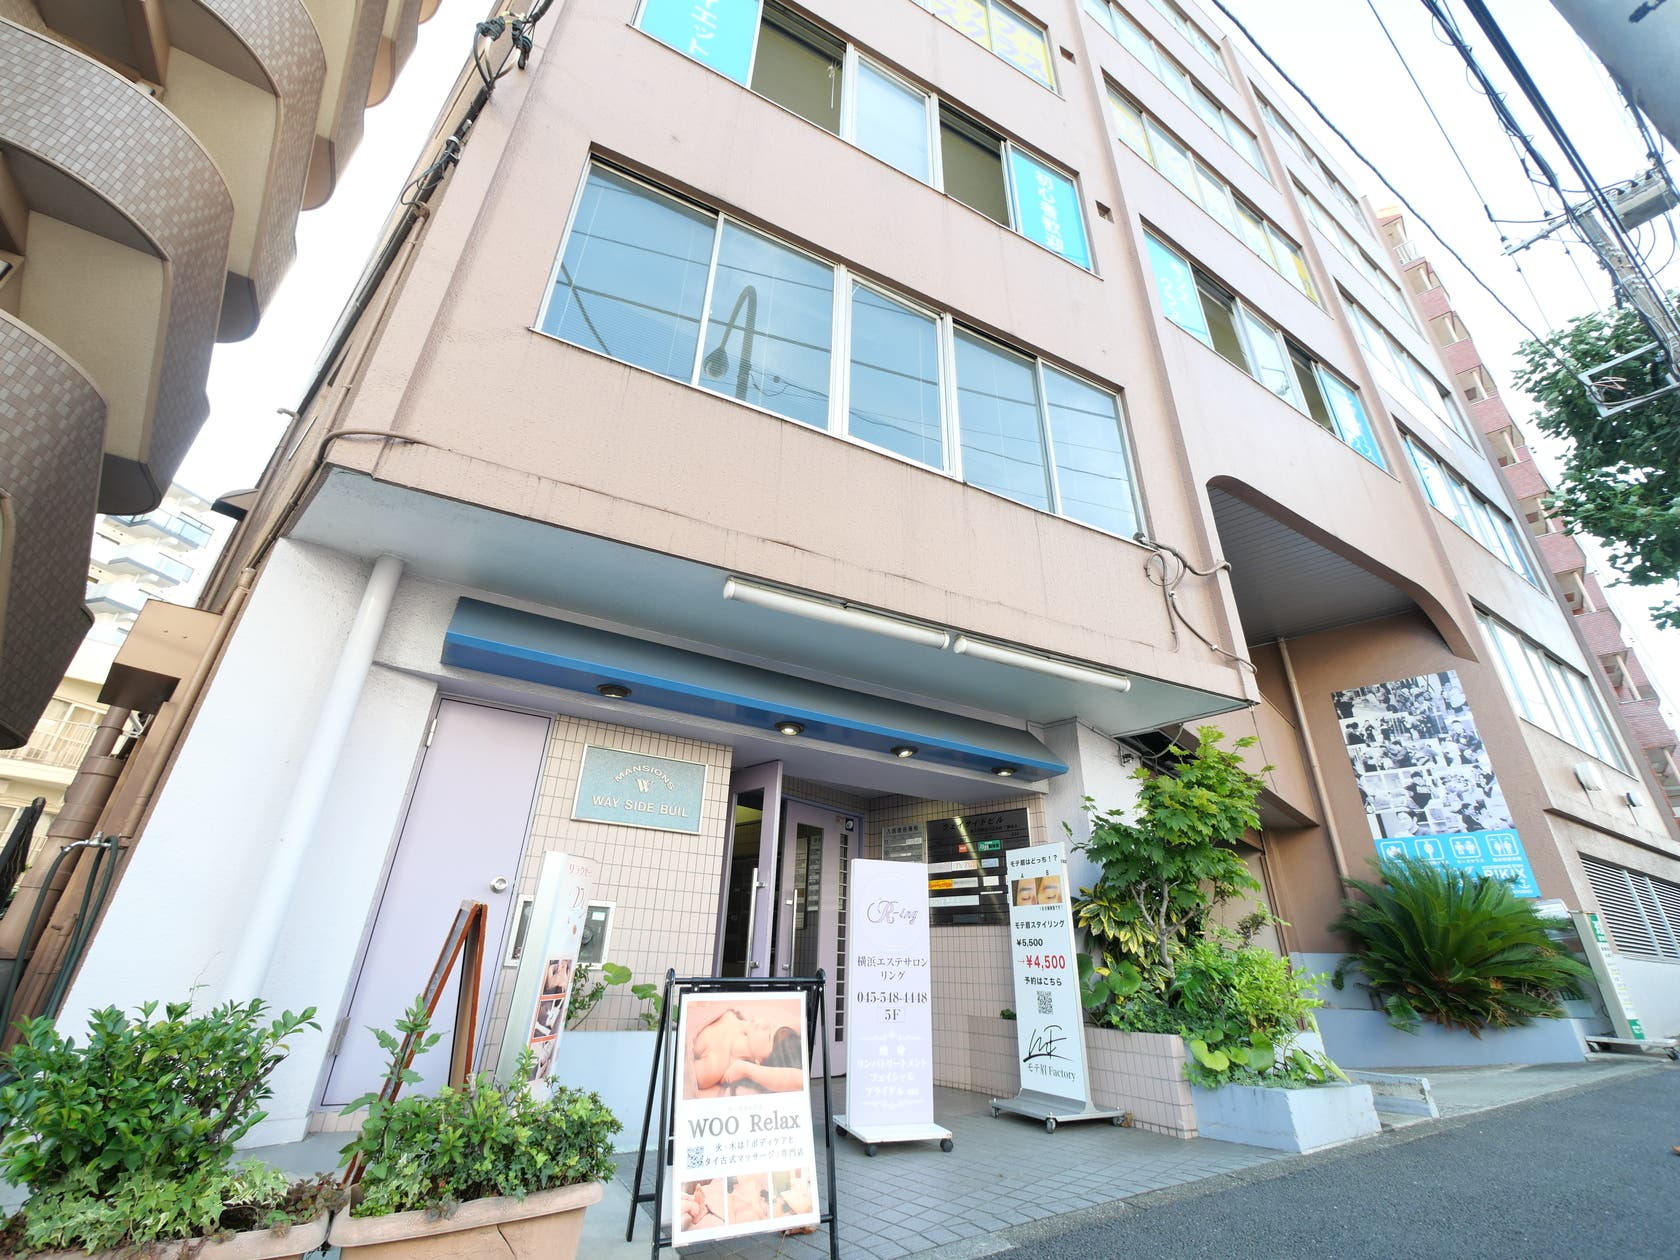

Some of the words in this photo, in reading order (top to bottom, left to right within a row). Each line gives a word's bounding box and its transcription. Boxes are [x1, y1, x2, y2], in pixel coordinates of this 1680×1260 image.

[614, 765, 676, 792] MANSIONS
[592, 795, 620, 808] WAY
[625, 799, 655, 813] SIDE
[660, 804, 689, 818] BUIL
[1015, 920, 1065, 930] モテ眉スタイリング
[1016, 938, 1044, 947] ¥5,500
[857, 955, 928, 967] 横浜エステサロン
[1026, 955, 1066, 971] ¥4,500
[881, 971, 906, 981] リング
[1024, 976, 1062, 986] 予約はこちら
[884, 1009, 901, 1021] 5F
[688, 1115, 740, 1139] WOO
[749, 1110, 801, 1133] Relax
